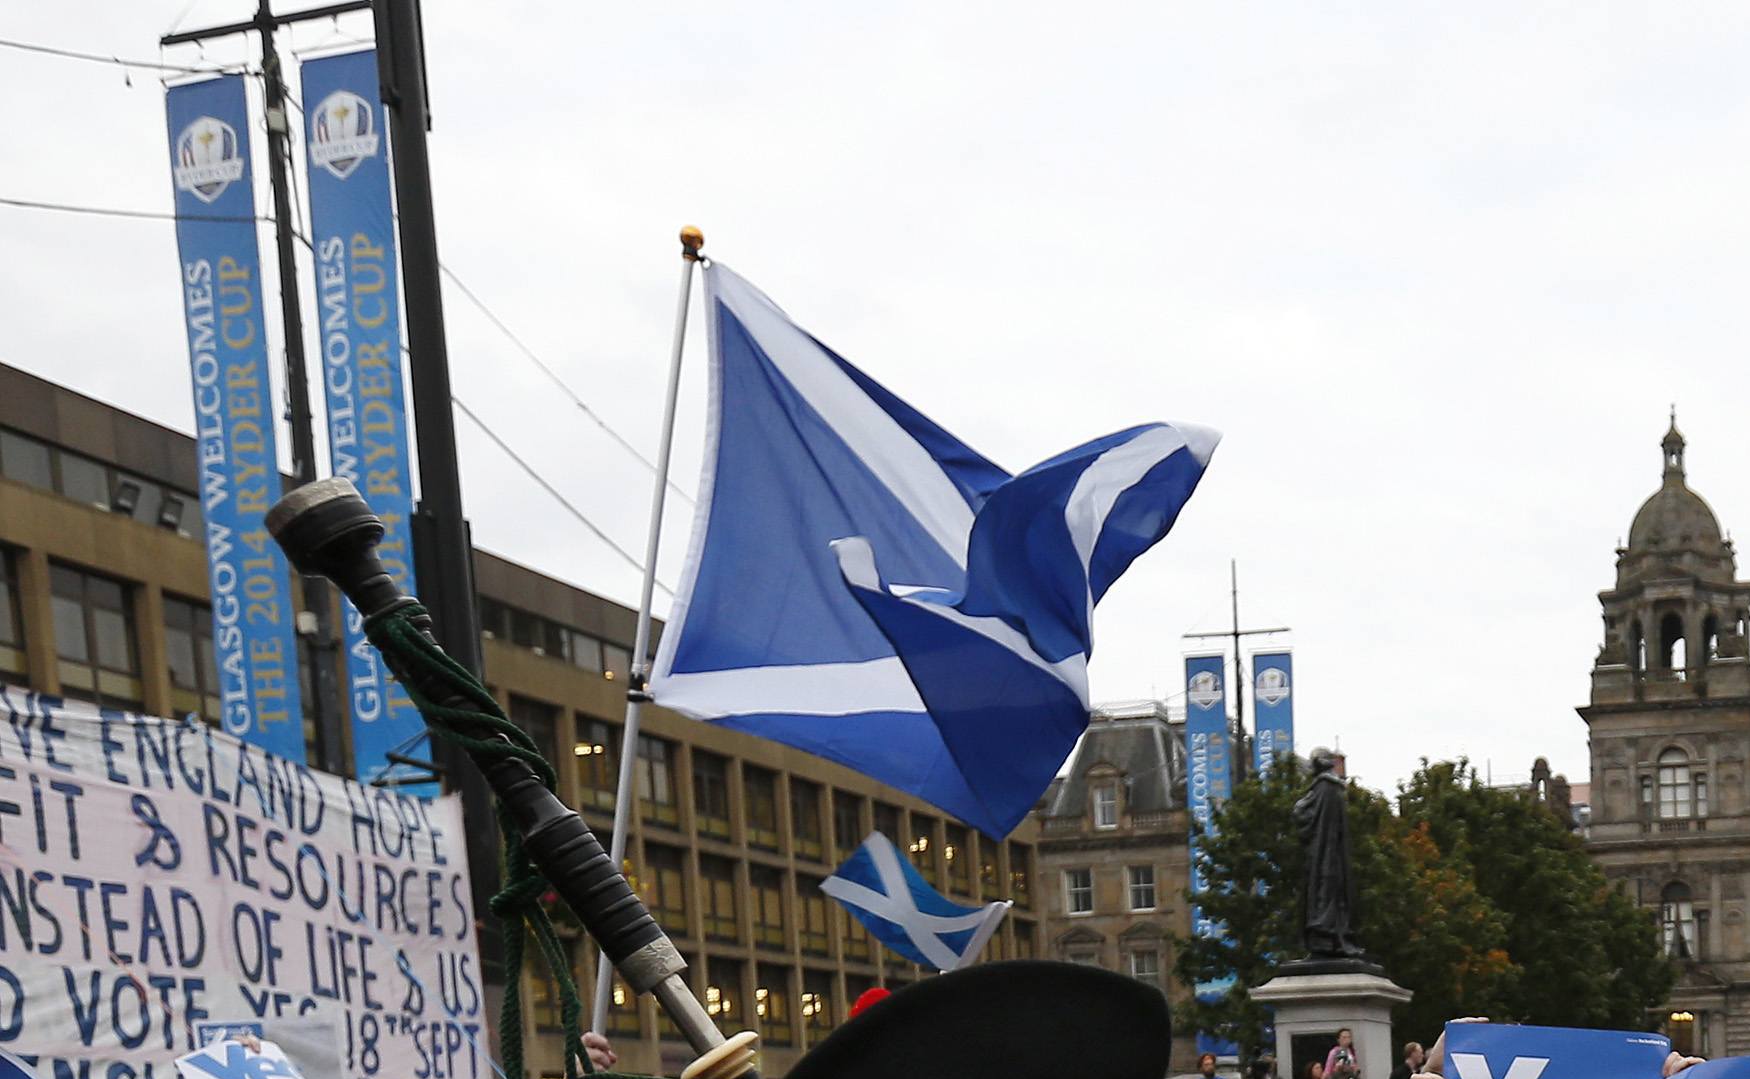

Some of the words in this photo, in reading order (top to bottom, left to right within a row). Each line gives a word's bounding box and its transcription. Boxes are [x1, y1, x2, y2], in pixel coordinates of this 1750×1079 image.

[218, 256, 256, 349] CUP
[351, 232, 388, 328] CUP
[187, 259, 229, 511] WELCOMES
[226, 361, 269, 515] RYDER
[356, 340, 400, 496] RYDER
[207, 520, 251, 735] GLASGOW
[240, 530, 281, 627] 2014
[379, 511, 411, 597] 014
[251, 636, 289, 733] THE
[100, 710, 325, 835] ENGLAND
[343, 776, 447, 866] HOPE
[130, 793, 182, 871] &
[203, 803, 468, 941] RESOURCES
[0, 867, 206, 967] NSTEAD
[232, 902, 283, 986] OF
[438, 952, 481, 1017] US
[62, 965, 209, 1050] VOTE
